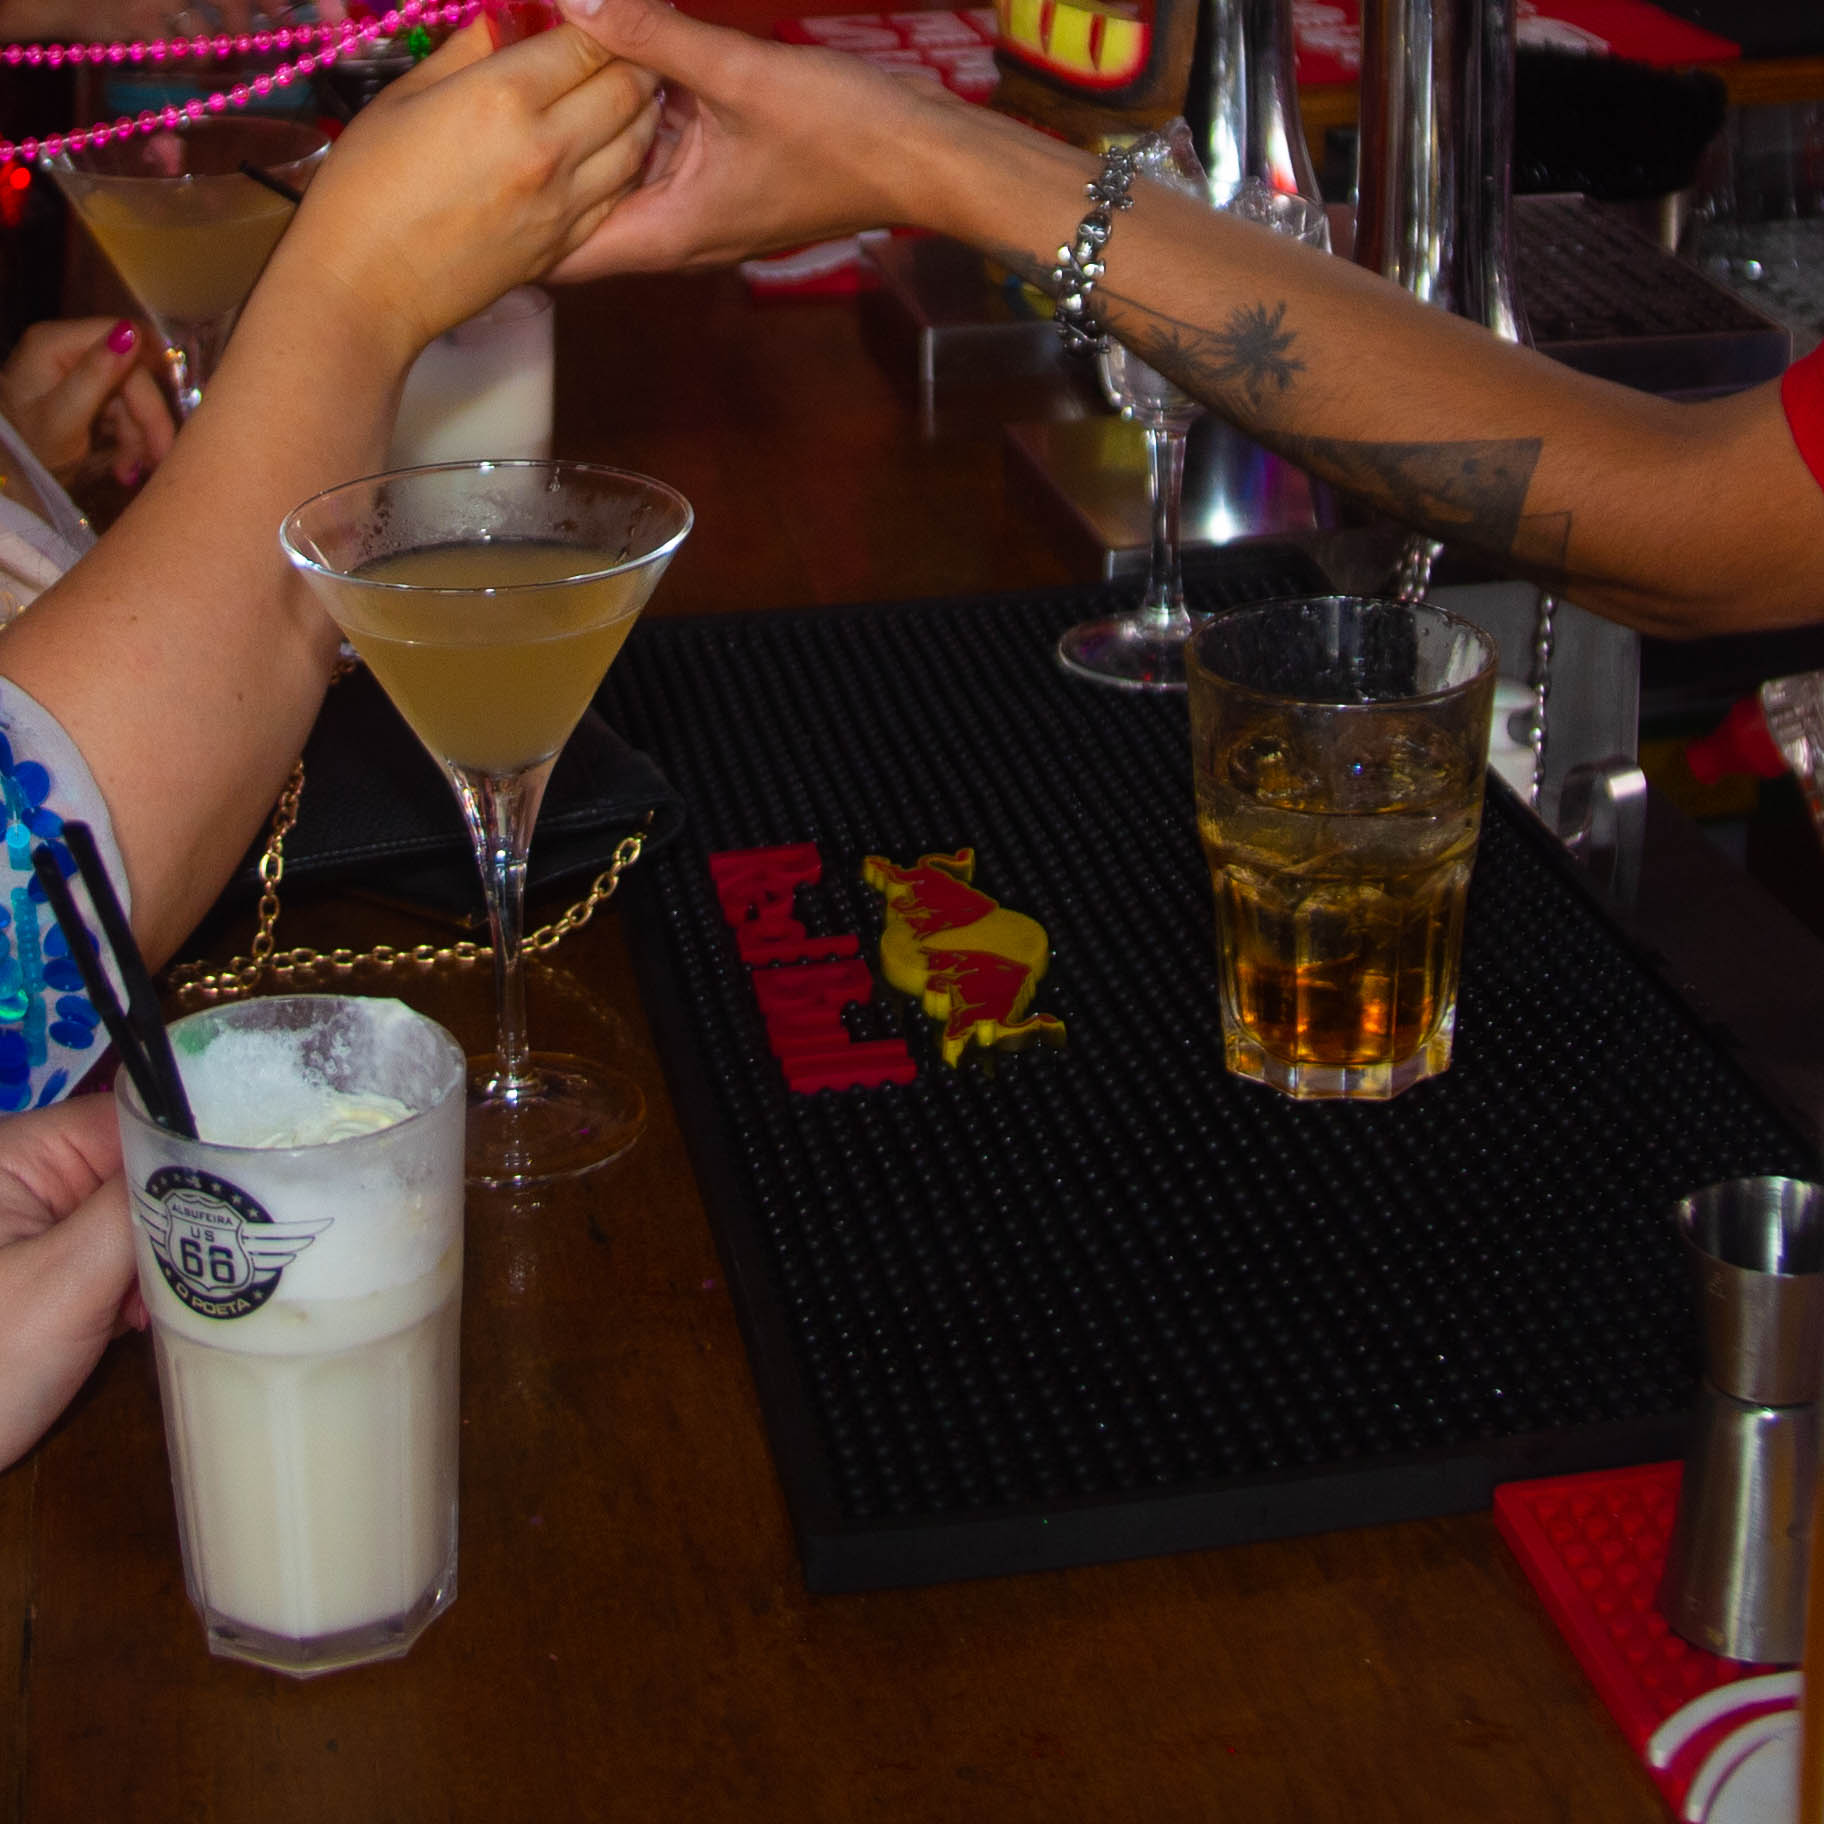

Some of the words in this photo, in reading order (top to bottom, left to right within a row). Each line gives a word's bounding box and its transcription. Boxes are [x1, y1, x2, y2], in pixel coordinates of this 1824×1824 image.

[172, 1204, 233, 1226] ALBUFEIRA
[190, 1226, 215, 1242] US
[179, 1236, 236, 1284] 66
[190, 1296, 252, 1316] POETA
